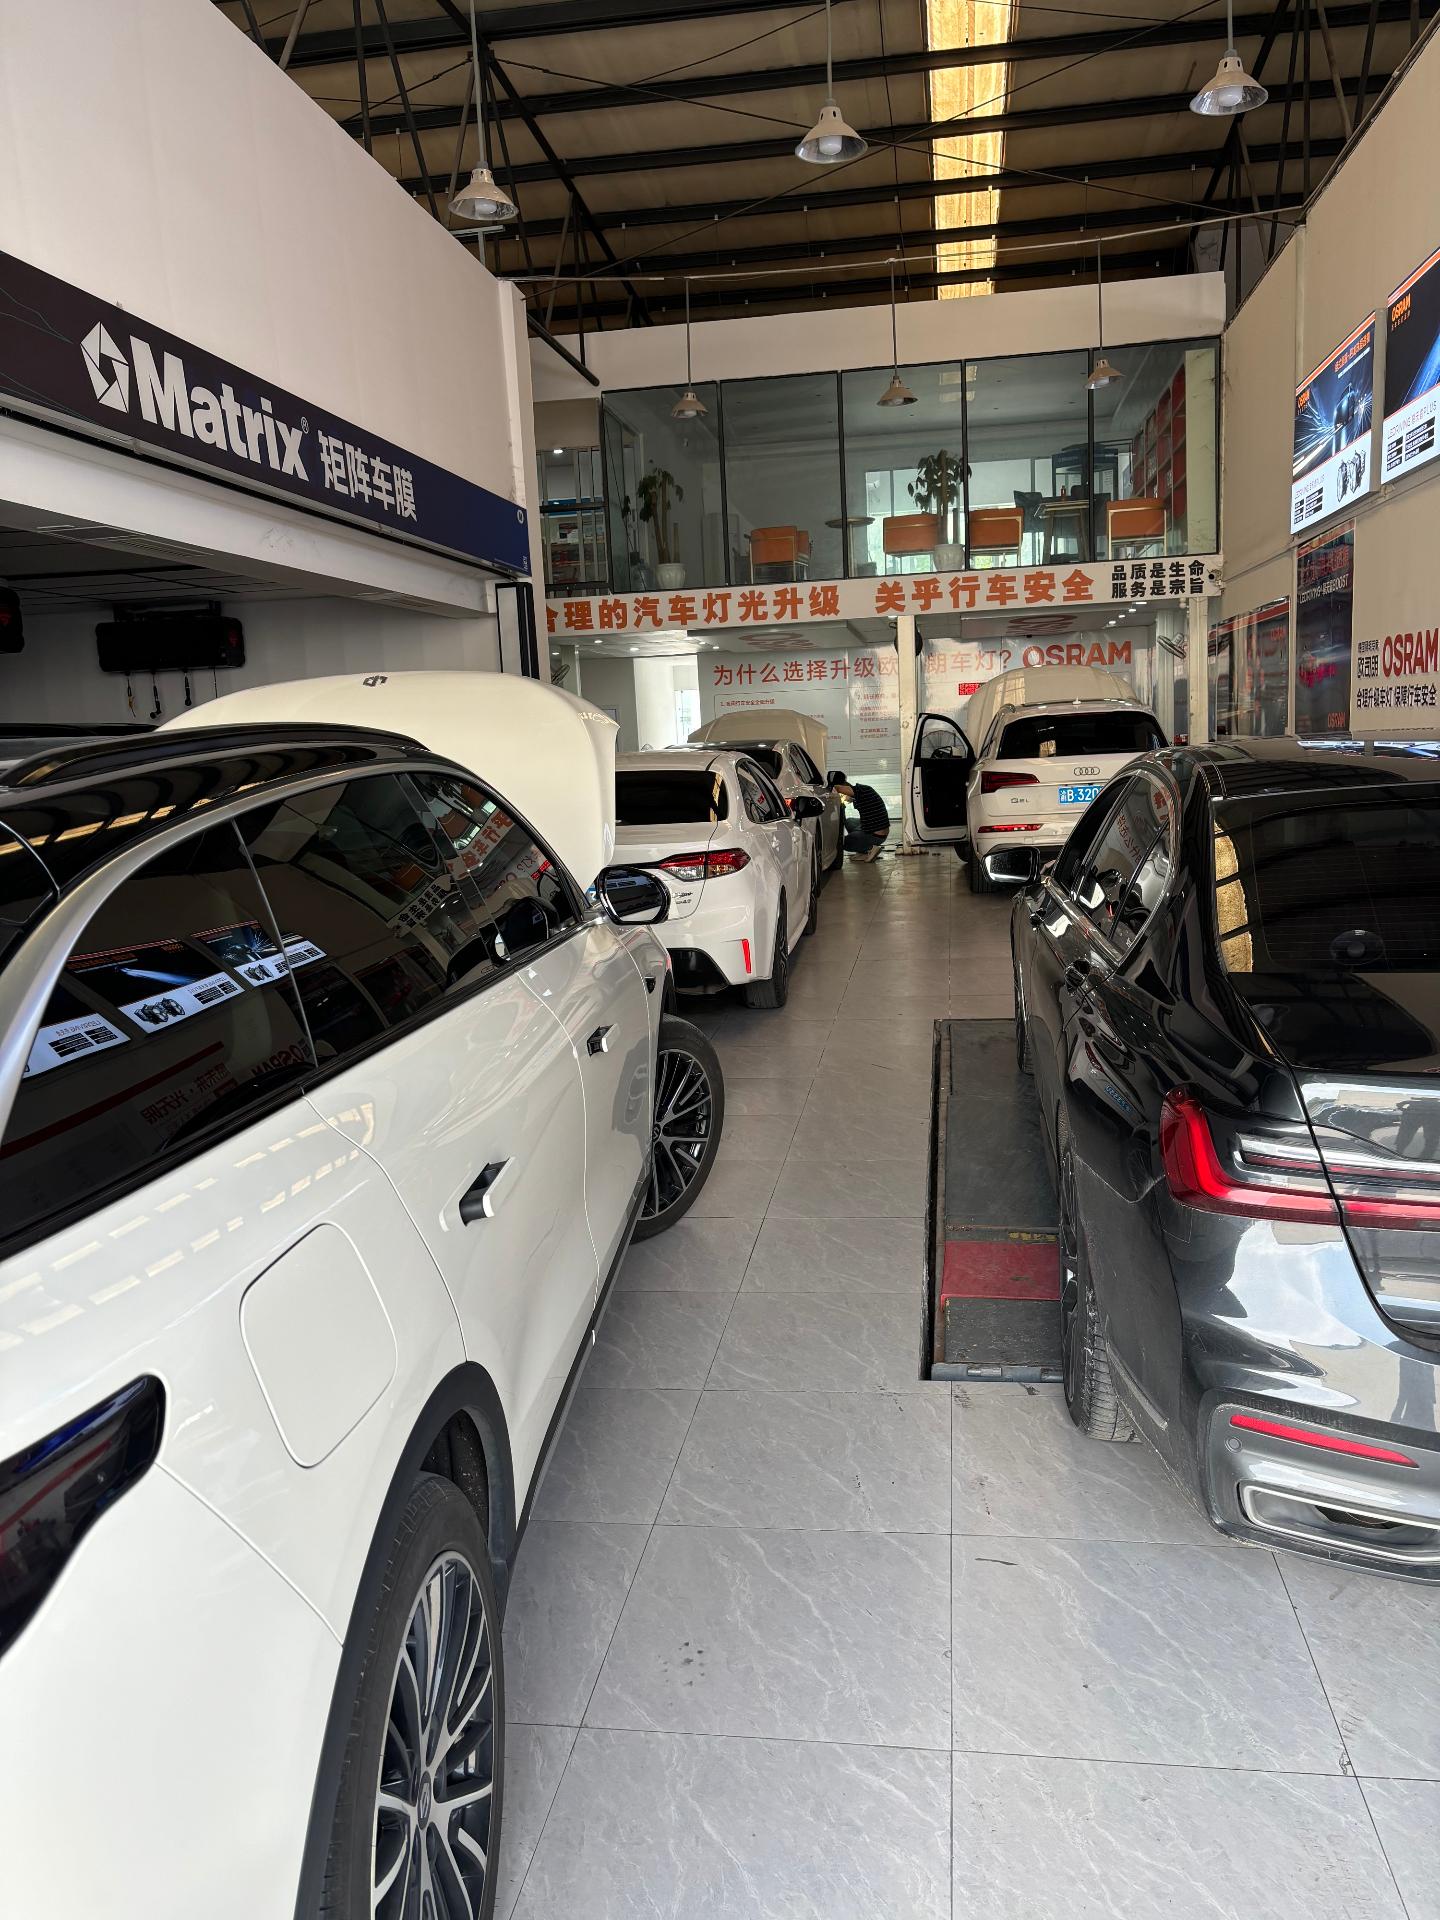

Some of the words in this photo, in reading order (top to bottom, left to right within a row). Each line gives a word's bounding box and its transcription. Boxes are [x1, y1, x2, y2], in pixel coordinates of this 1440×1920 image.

[318, 430, 417, 522] 矩阵车膜
[1112, 560, 1205, 581] 品质是生命
[875, 569, 1095, 614] 关乎行车安全
[1112, 577, 1204, 598] 服务是宗旨
[1023, 640, 1132, 667] OSRAM
[1383, 628, 1438, 677] OSRAM
[1357, 655, 1379, 678] 欧司朗
[1357, 687, 1392, 708] 合理升级车灯
[1394, 683, 1436, 708] 保障行车安全
